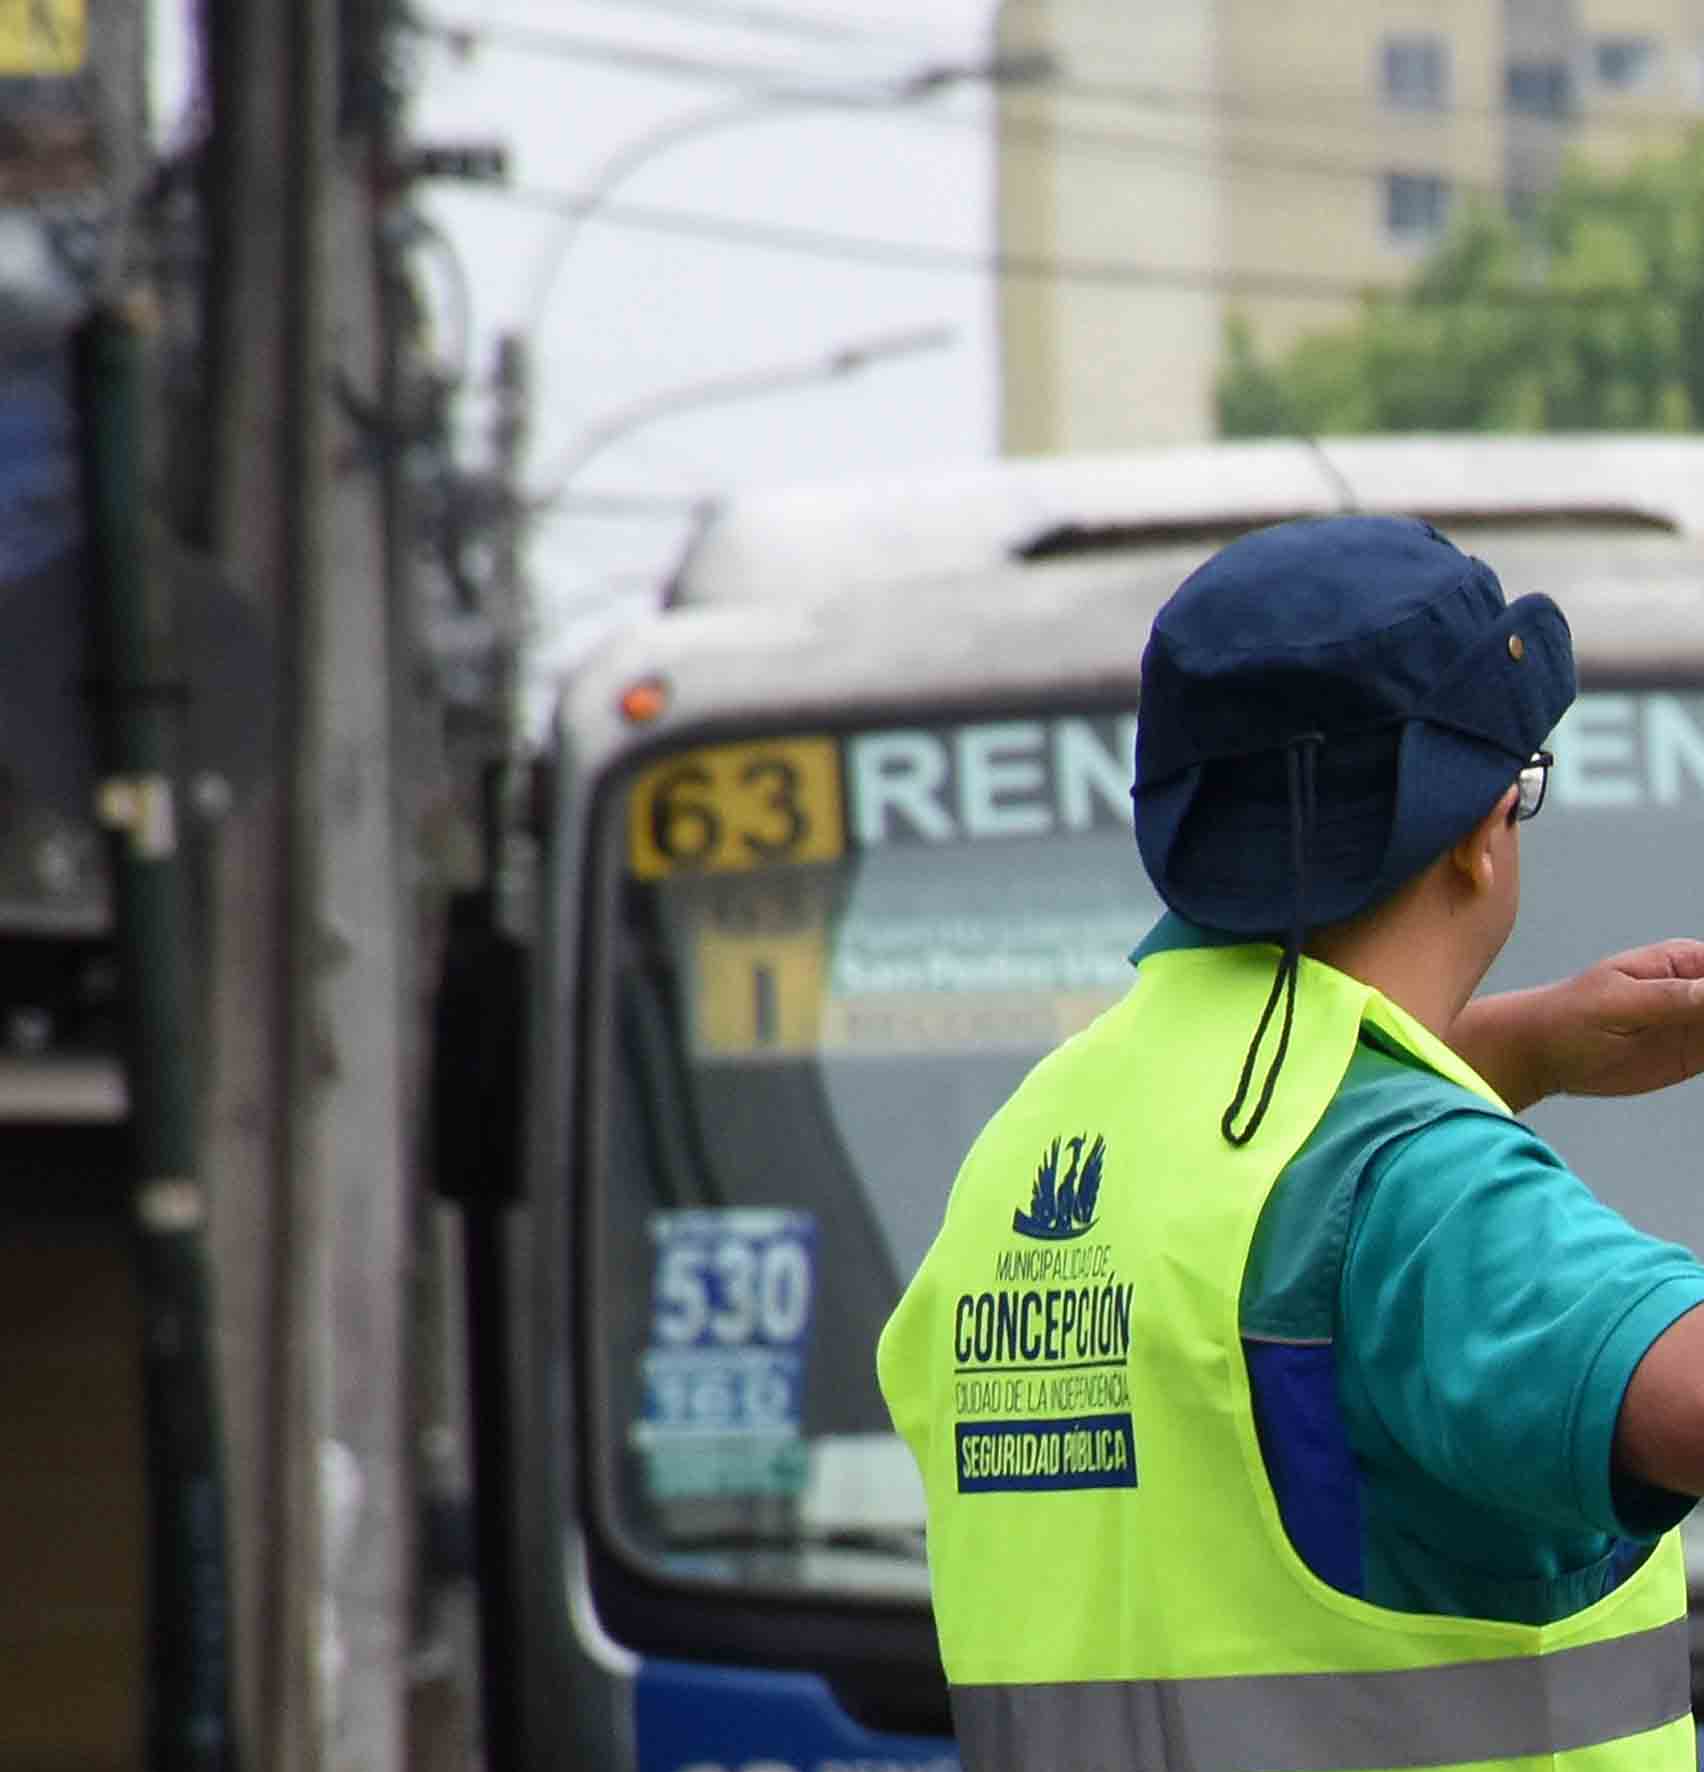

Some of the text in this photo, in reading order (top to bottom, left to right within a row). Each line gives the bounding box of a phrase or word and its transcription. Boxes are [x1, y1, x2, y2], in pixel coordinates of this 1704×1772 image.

[650, 756, 811, 860] 63
[656, 1239, 811, 1343] 530
[994, 1243, 1112, 1281] MUNICIPALIDAD DE
[954, 1271, 1134, 1364] CONCEPCIÓN
[955, 1370, 1131, 1415] CIUDAD DE LA INDEPENDENCIA
[961, 1423, 1128, 1479] SEGURIDAD PÚBLICA
